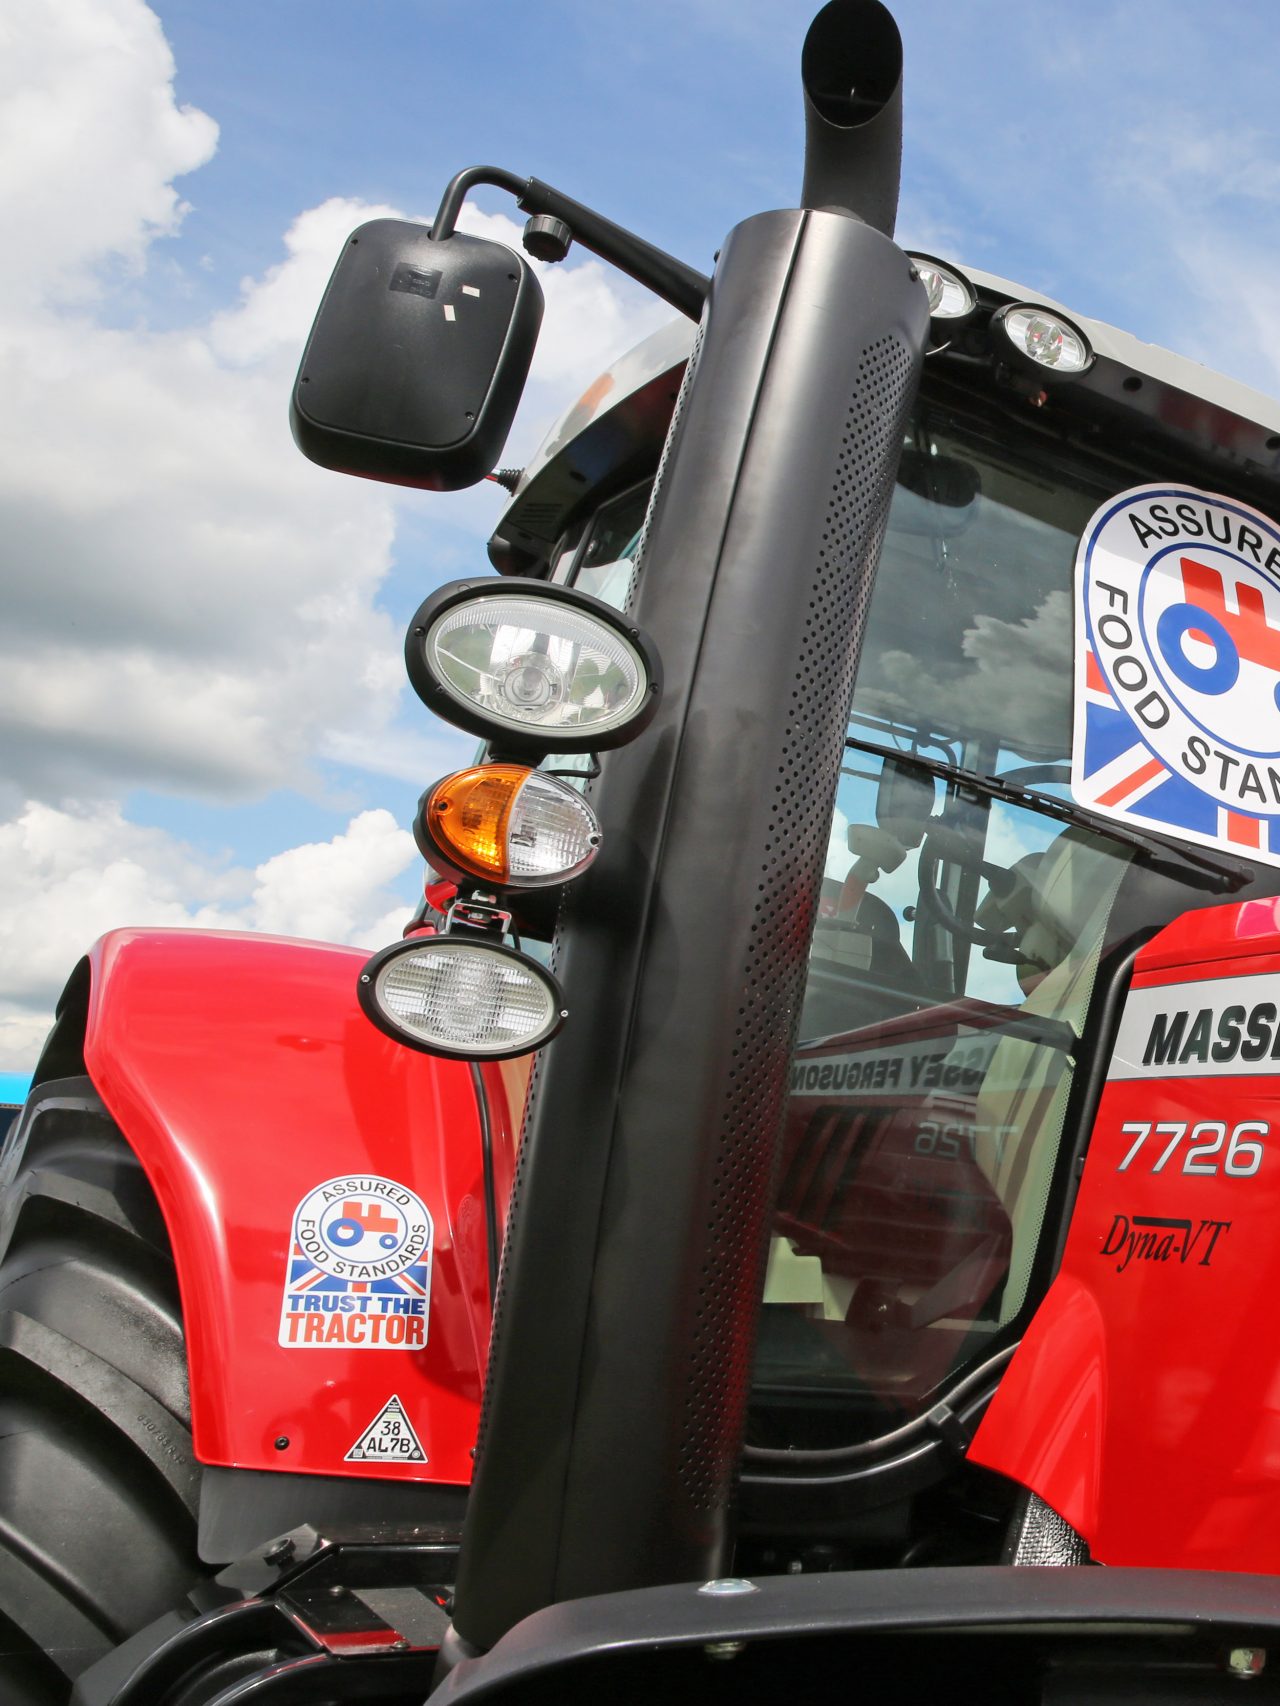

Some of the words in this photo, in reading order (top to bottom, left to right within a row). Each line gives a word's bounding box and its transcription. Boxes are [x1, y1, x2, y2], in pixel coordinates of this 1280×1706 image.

[1095, 580, 1171, 729] FOOD
[1116, 1120, 1270, 1178] 7726
[322, 1180, 411, 1207] ASSURED
[300, 1218, 329, 1264] FOOD
[332, 1223, 426, 1279] STANDARDS
[1099, 1215, 1232, 1273] Dyna-VT
[287, 1294, 372, 1313] TRUST
[374, 1296, 425, 1315] THE
[285, 1312, 425, 1345] TRACTOR
[380, 1420, 401, 1436] 38
[366, 1437, 411, 1454] AL7B
